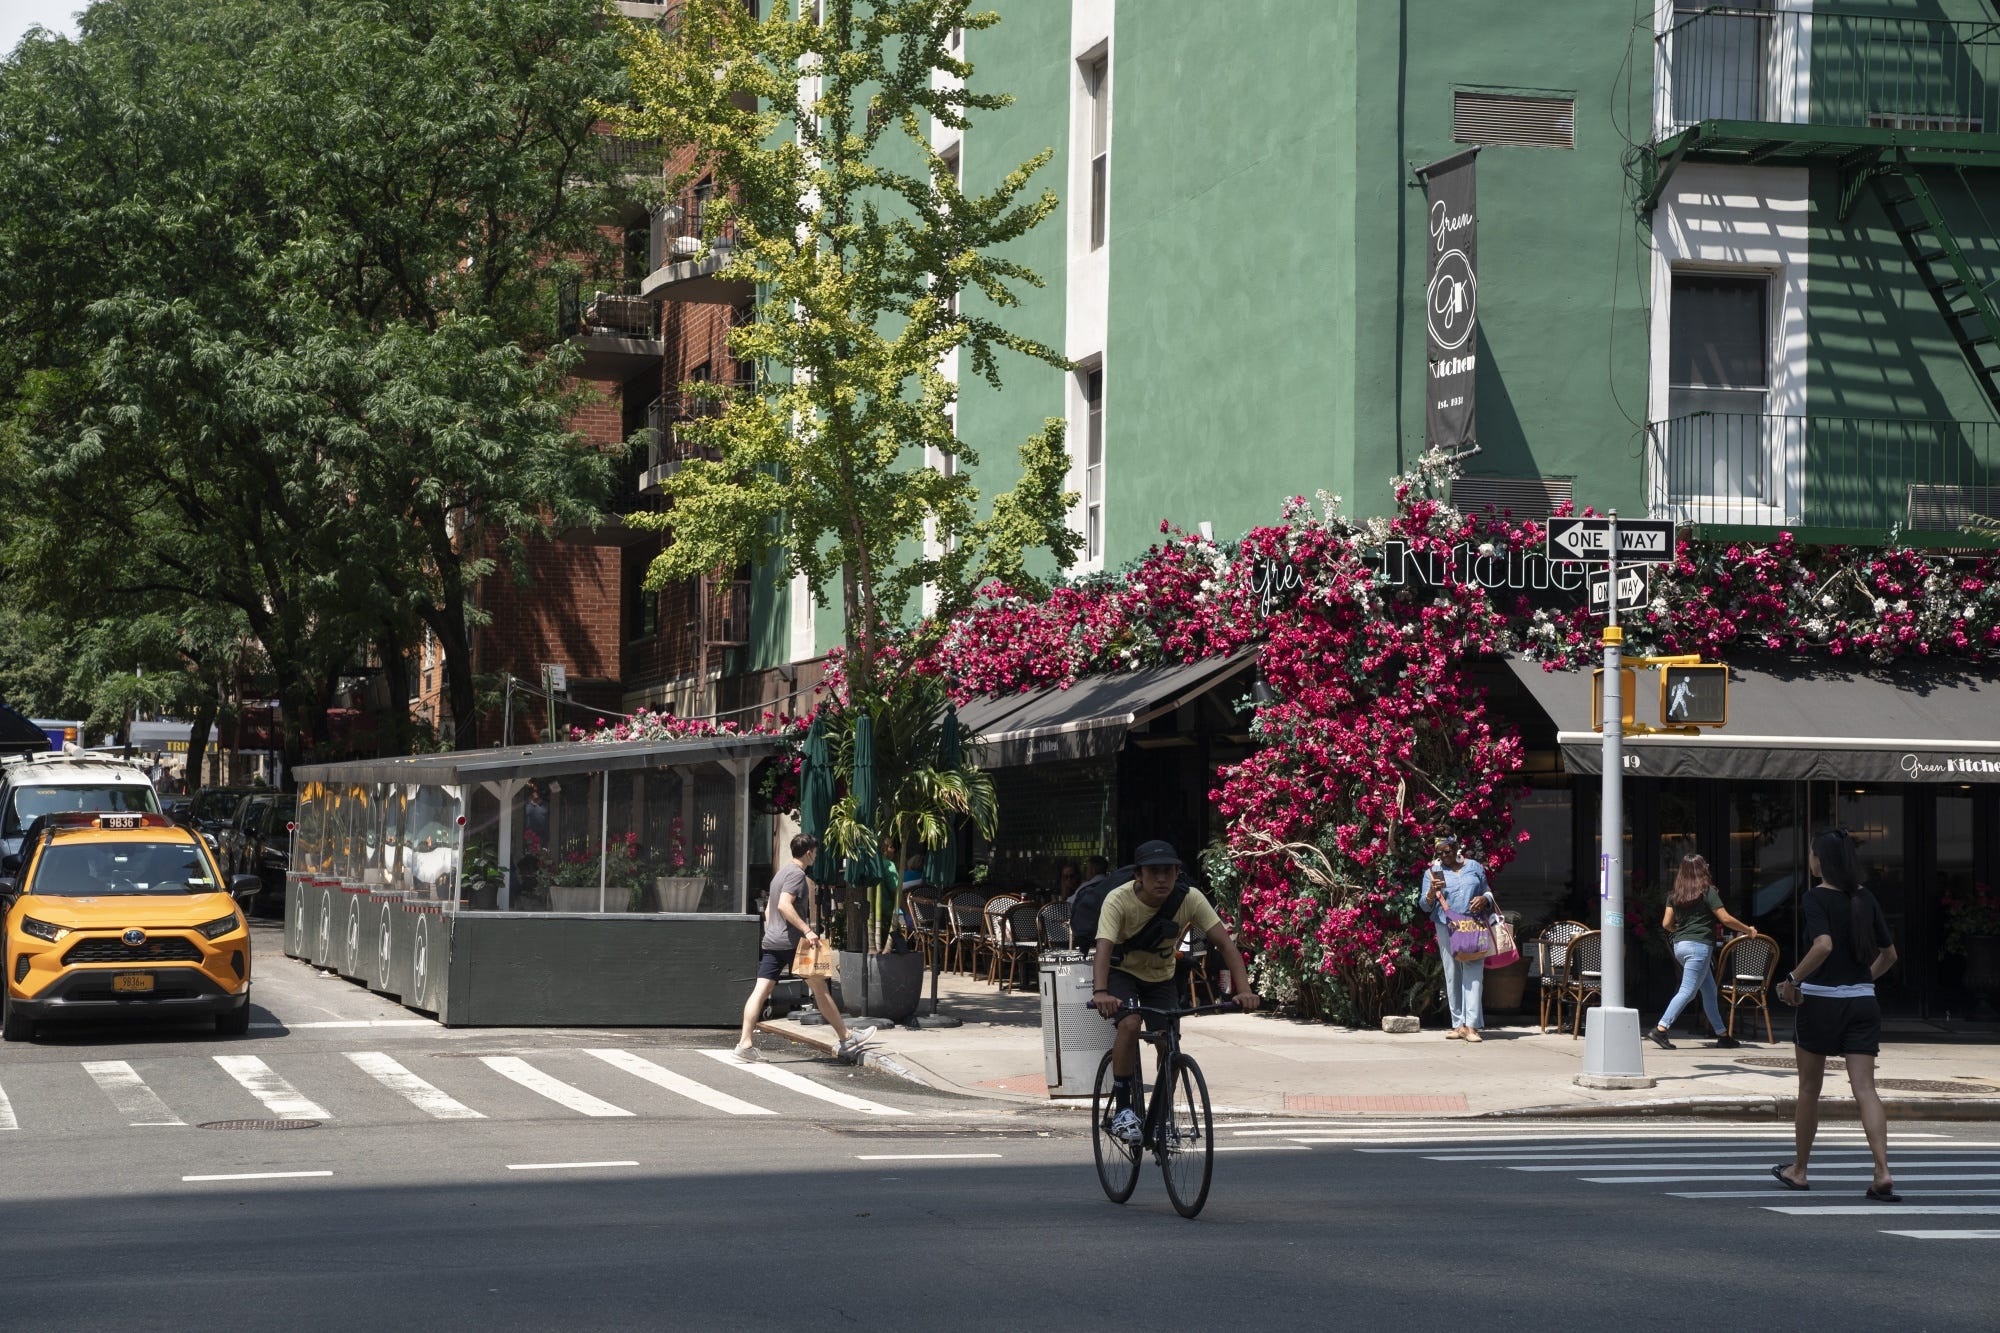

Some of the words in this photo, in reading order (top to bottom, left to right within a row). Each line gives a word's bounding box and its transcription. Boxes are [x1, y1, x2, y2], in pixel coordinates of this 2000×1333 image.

[1431, 200, 1473, 251] Green
[1568, 531, 1603, 548] ONE
[1620, 533, 1658, 549] WAY
[1385, 541, 1630, 591] Kitche
[1621, 578, 1640, 597] WAY
[1622, 754, 1641, 768] 19
[1900, 753, 1946, 779] Green
[1947, 757, 2000, 773] Kitche
[109, 817, 134, 828] 9B36
